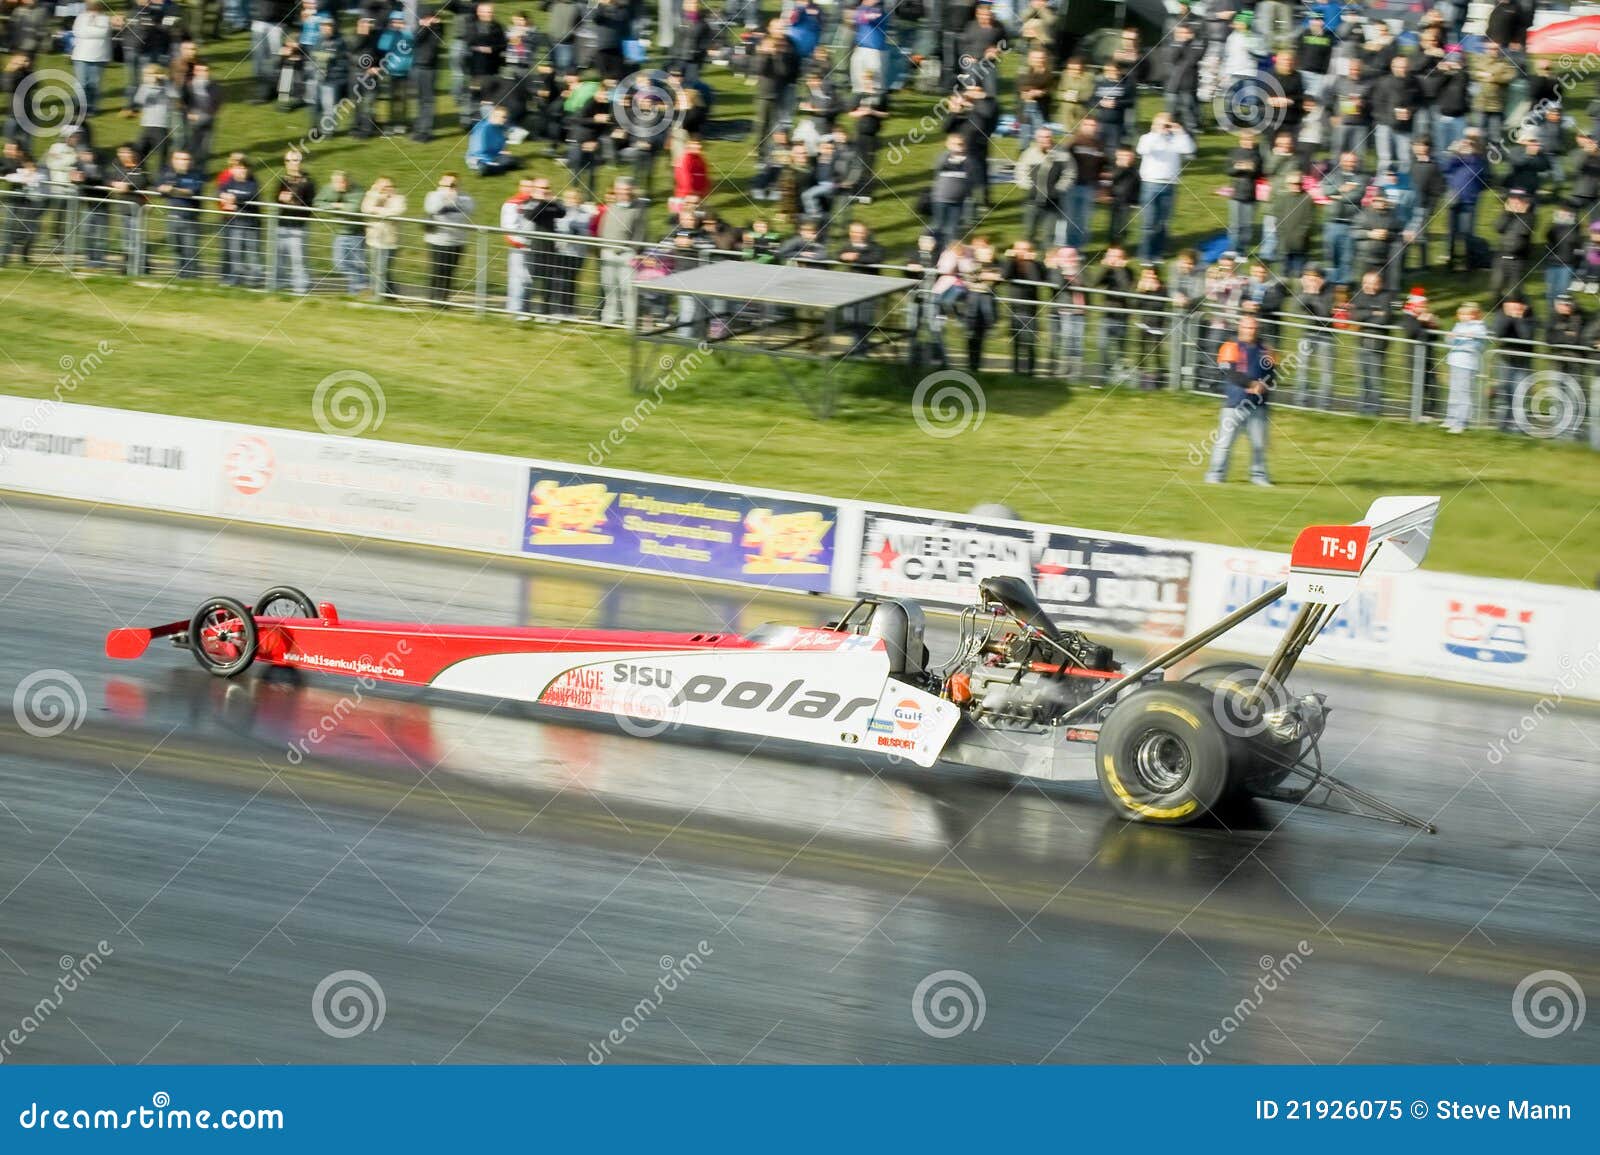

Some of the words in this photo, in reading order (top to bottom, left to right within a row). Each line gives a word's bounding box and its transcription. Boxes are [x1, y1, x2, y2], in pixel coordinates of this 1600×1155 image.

[1320, 535, 1357, 561] TF-9
[566, 668, 604, 690] PAGE
[613, 663, 673, 689] SISU
[668, 675, 878, 722] polar
[894, 708, 923, 722] Gulf
